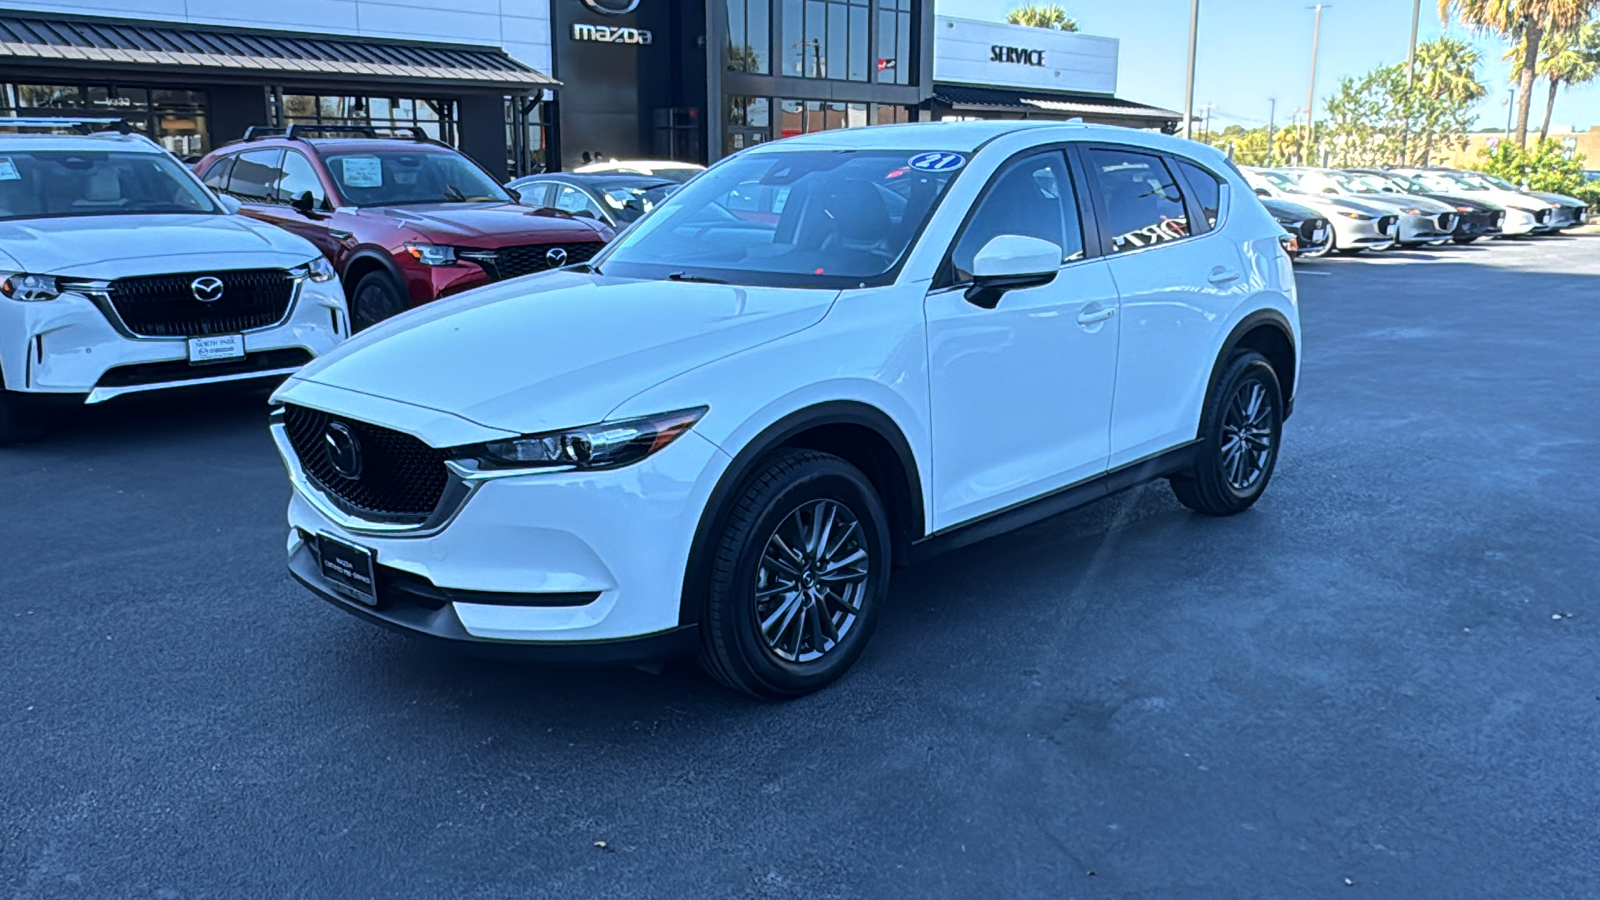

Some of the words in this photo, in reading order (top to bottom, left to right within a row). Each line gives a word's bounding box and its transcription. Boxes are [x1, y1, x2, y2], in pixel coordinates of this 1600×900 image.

[573, 23, 652, 44] mazda
[990, 45, 1046, 67] SERVICE
[915, 153, 956, 169] 21
